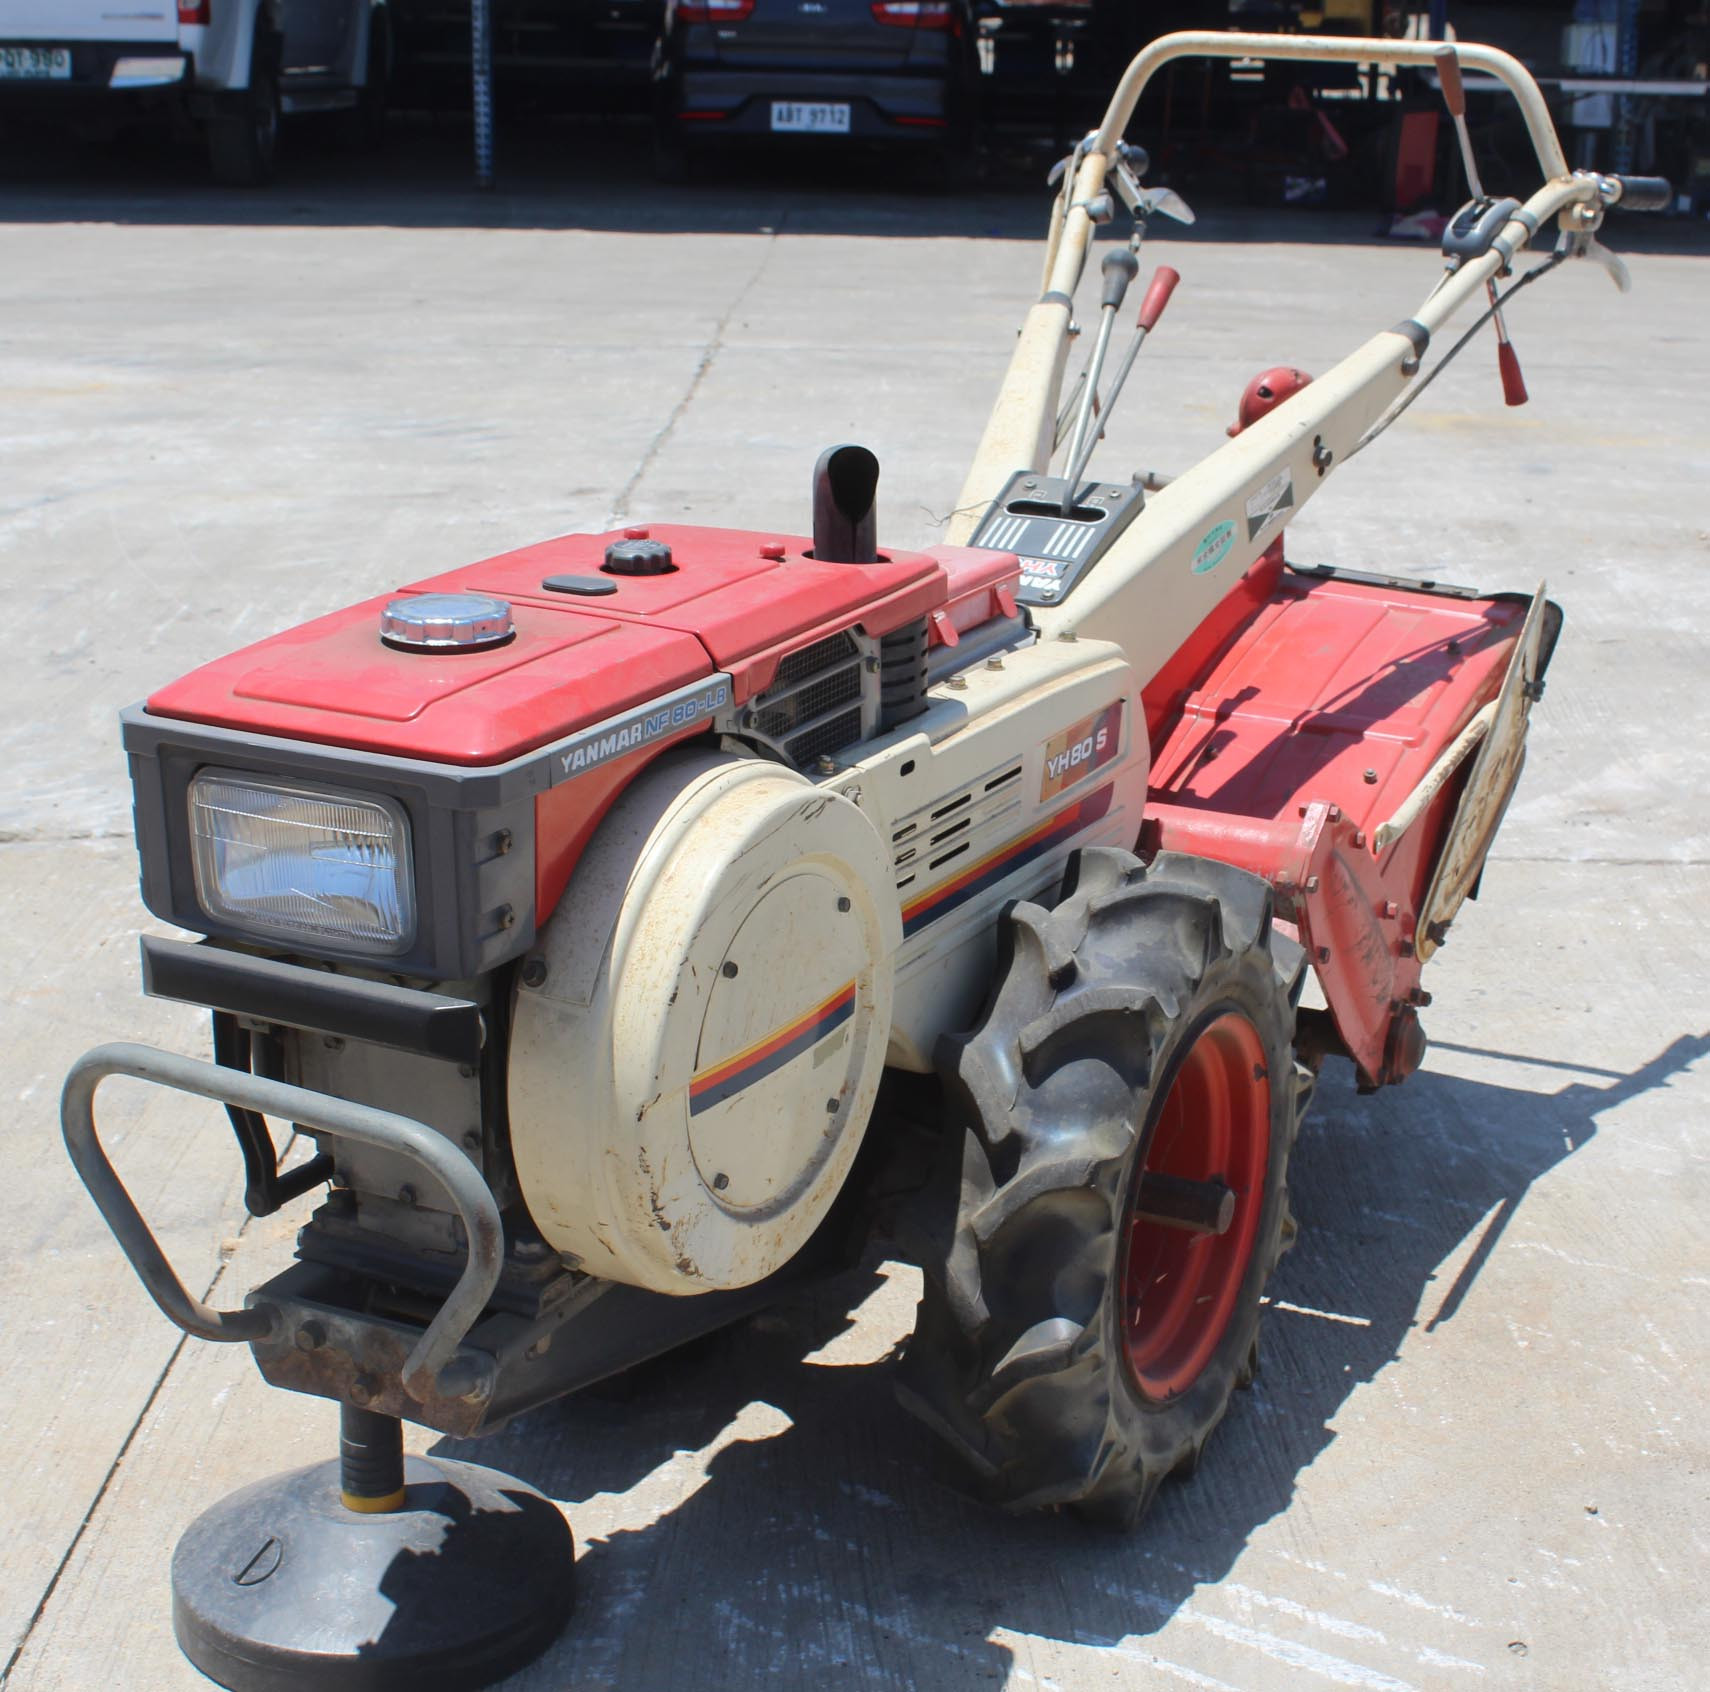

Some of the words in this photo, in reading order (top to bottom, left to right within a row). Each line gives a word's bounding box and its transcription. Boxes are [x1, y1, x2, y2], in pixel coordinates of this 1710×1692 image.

[561, 723, 642, 774] YANMAR
[644, 709, 670, 738] NF
[672, 687, 726, 725] 80-LB
[1047, 736, 1093, 778] YH80
[1096, 727, 1108, 751] S
